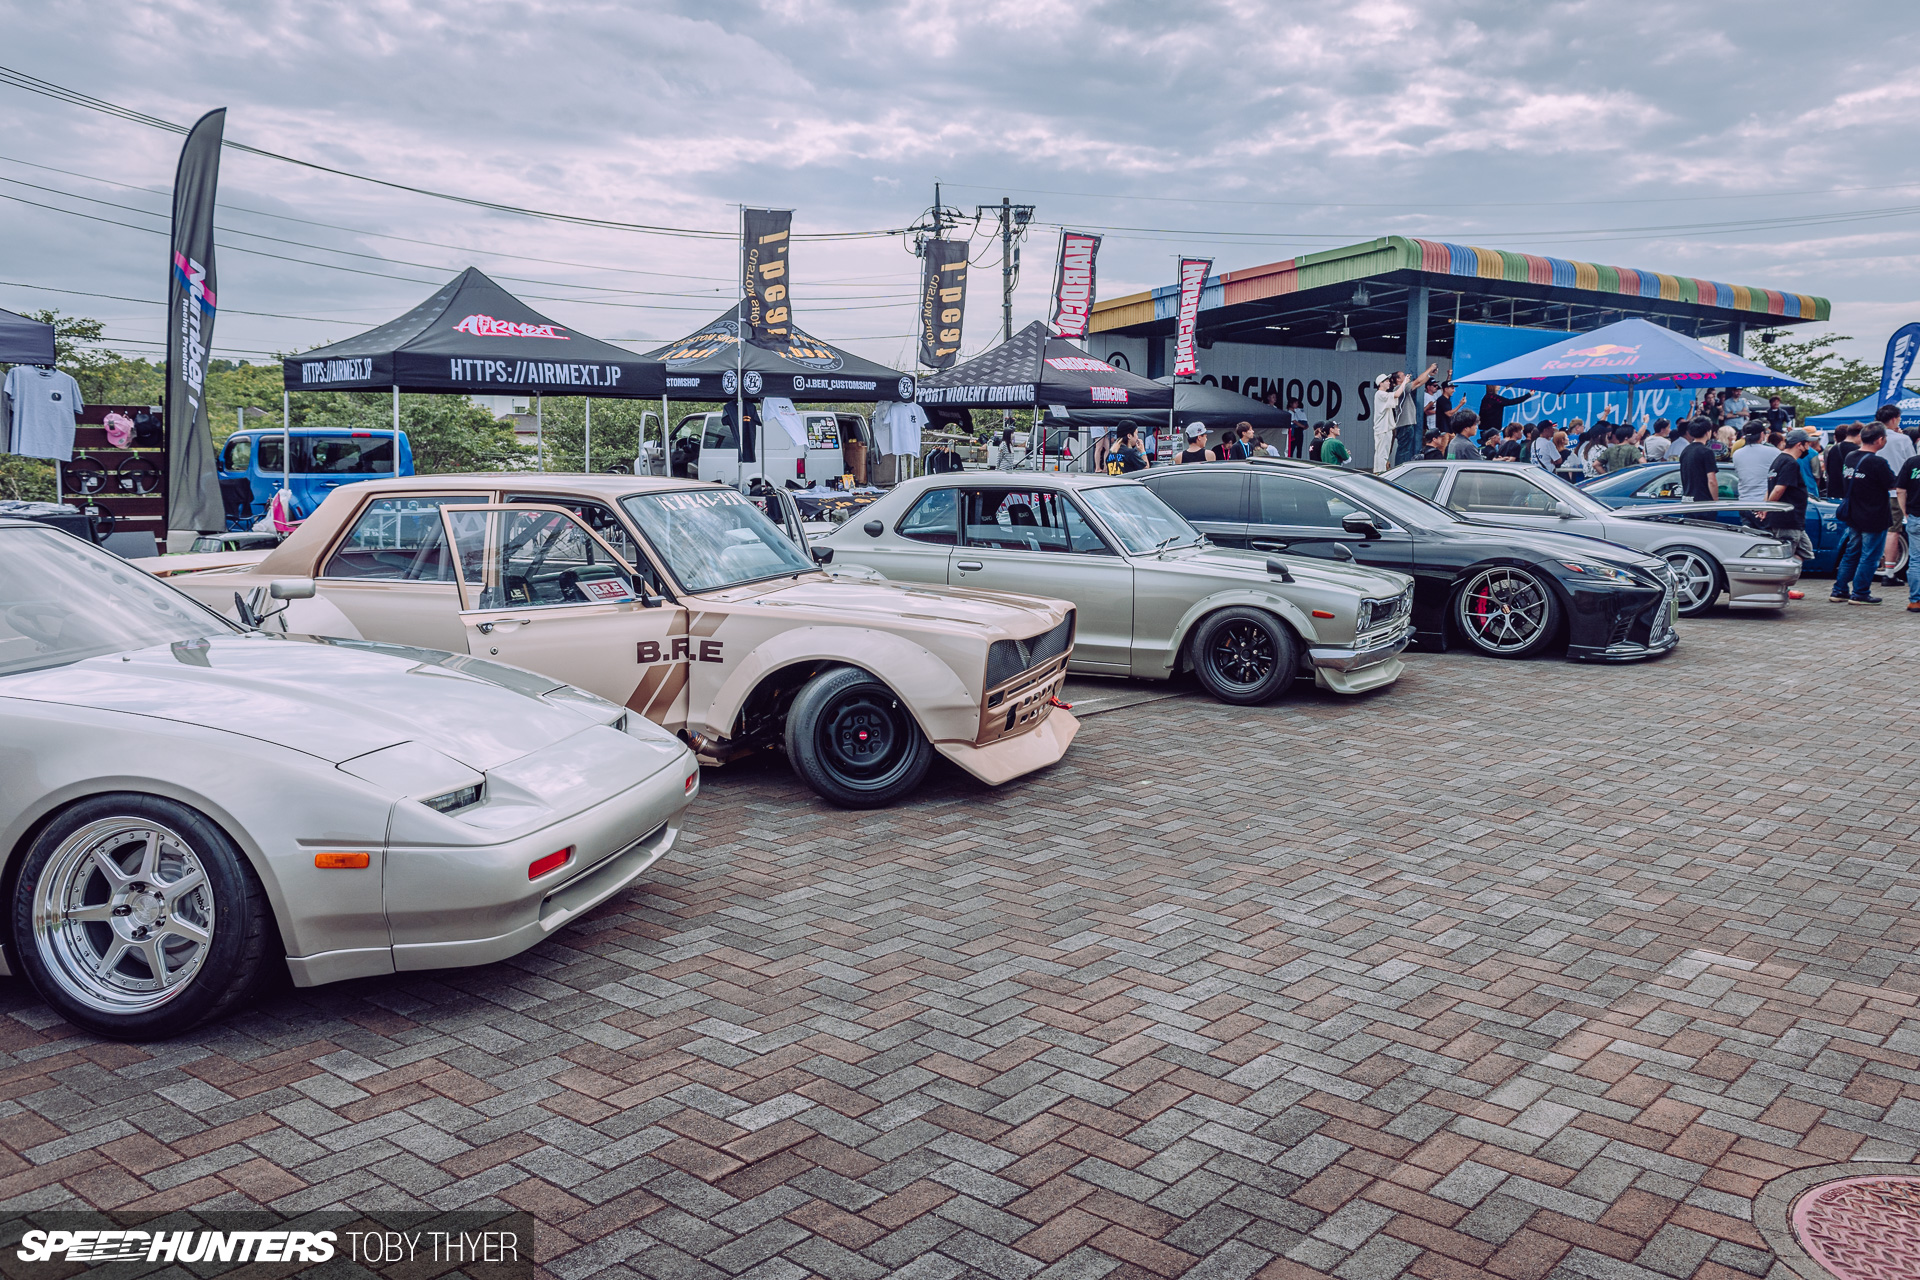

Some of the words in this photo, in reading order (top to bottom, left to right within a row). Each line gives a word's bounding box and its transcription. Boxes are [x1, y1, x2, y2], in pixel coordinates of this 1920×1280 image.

[189, 258, 206, 396] Number
[452, 314, 570, 340] AIRMEXT
[1174, 264, 1207, 374] HARDCORE
[302, 358, 372, 384] HTTPS://AIRMEXT.JP
[450, 358, 621, 387] HTTPS://AIRMEXT.JP
[1541, 357, 1589, 371] Red
[1589, 355, 1640, 368] Bull
[805, 379, 877, 391] J.BEAT_CUSTOMSHOP
[946, 386, 989, 402] VIOLENT
[988, 384, 1035, 401] DRIVING
[1092, 387, 1128, 402] HARDCORE
[590, 582, 624, 595] B.R.E
[636, 638, 724, 664] B.R.E
